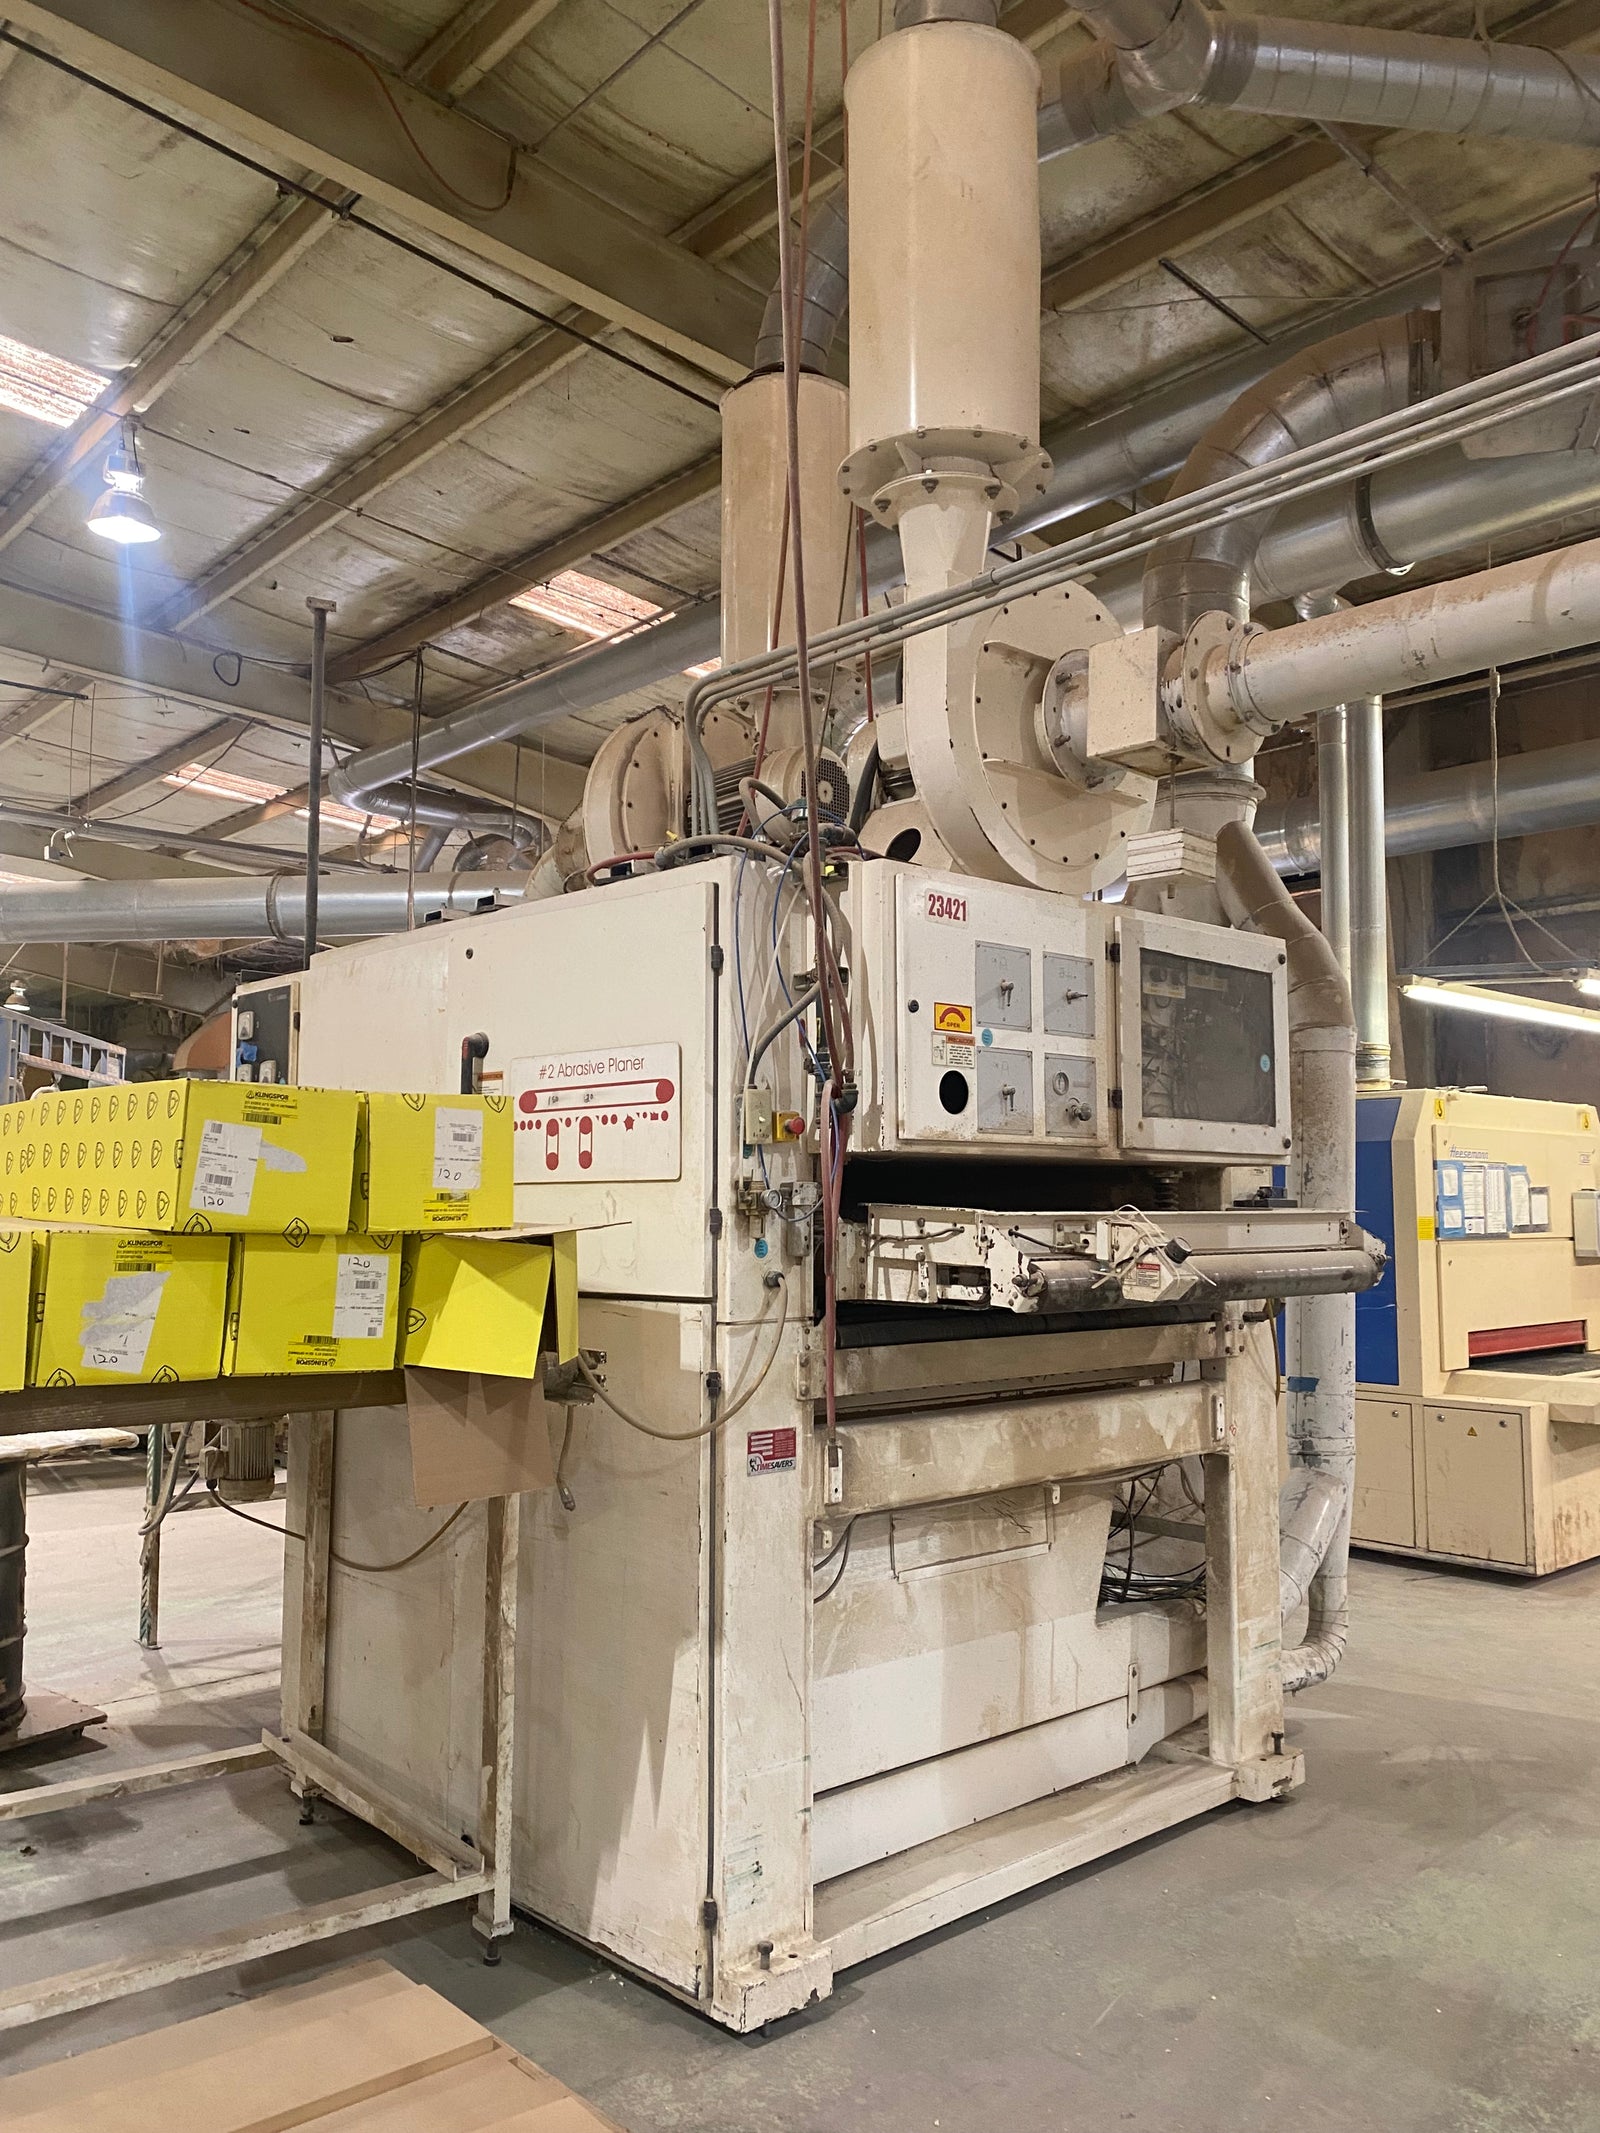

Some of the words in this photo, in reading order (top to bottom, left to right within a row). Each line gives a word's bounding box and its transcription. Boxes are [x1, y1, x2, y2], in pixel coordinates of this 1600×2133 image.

[928, 893, 967, 922] 23421
[946, 1021, 961, 1029] OPEN
[539, 1064, 555, 1079] #2
[557, 1061, 605, 1078] Abrasive
[608, 1056, 645, 1072] Planer
[255, 1091, 289, 1100] KLINGSPOR
[438, 1167, 462, 1181] 120
[203, 1195, 224, 1207] 120
[127, 1239, 164, 1247] KLINGSPOR
[347, 1256, 371, 1268] 120
[92, 1354, 118, 1365] 120
[755, 1459, 794, 1472] TIMESAVERS
